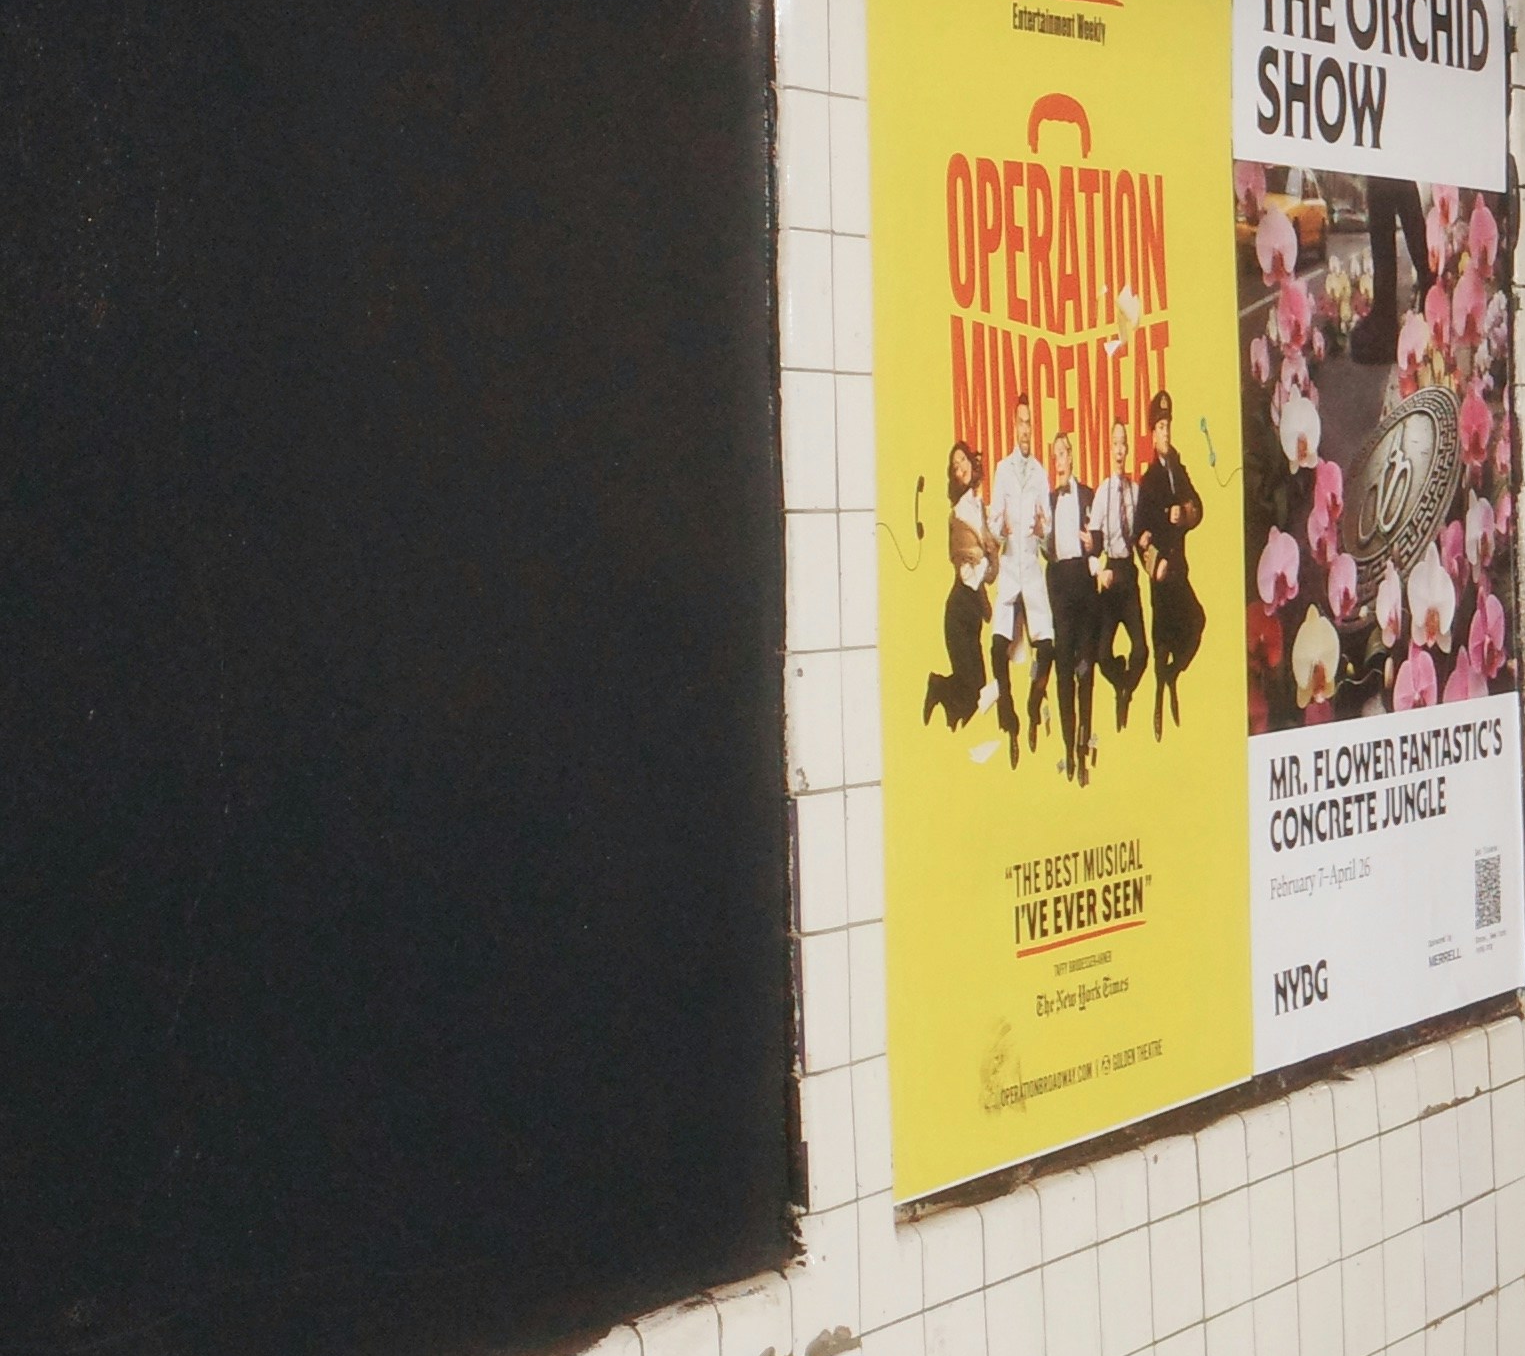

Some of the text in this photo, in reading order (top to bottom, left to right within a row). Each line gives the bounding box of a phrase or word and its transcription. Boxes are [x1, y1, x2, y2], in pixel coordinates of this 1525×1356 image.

[1012, 3, 1106, 45] Entertainment Weekly
[1256, 45, 1387, 150] SHOW
[946, 153, 1168, 336] OPERATION
[1269, 755, 1308, 801] MR.
[1314, 738, 1396, 793] FLOWER
[1270, 776, 1447, 853] CONCRETE JUNGLE
[1045, 851, 1080, 891] BEST
[1083, 839, 1144, 883] MUSICAL
[1270, 874, 1316, 901] February
[1359, 856, 1371, 879] 26
[1053, 888, 1098, 935] EVER
[1036, 976, 1129, 1018] The New York Times
[1273, 959, 1329, 1017] NYBG
